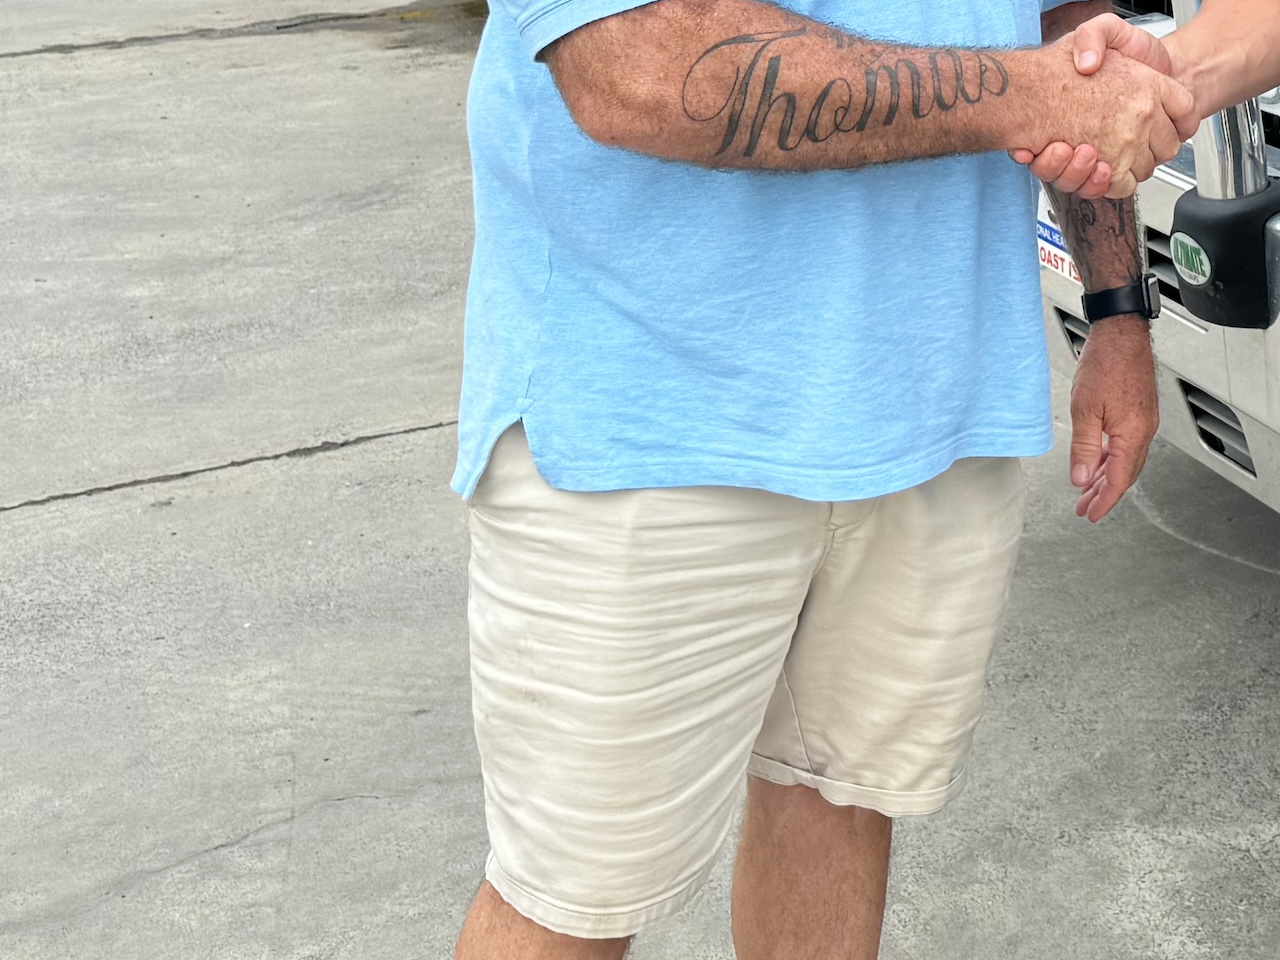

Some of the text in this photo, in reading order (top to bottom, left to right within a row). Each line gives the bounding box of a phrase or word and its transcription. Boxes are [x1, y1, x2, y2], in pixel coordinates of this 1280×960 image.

[682, 26, 1009, 157] Thomas
[1036, 224, 1052, 241] ONAL
[1040, 246, 1066, 273] OAST
